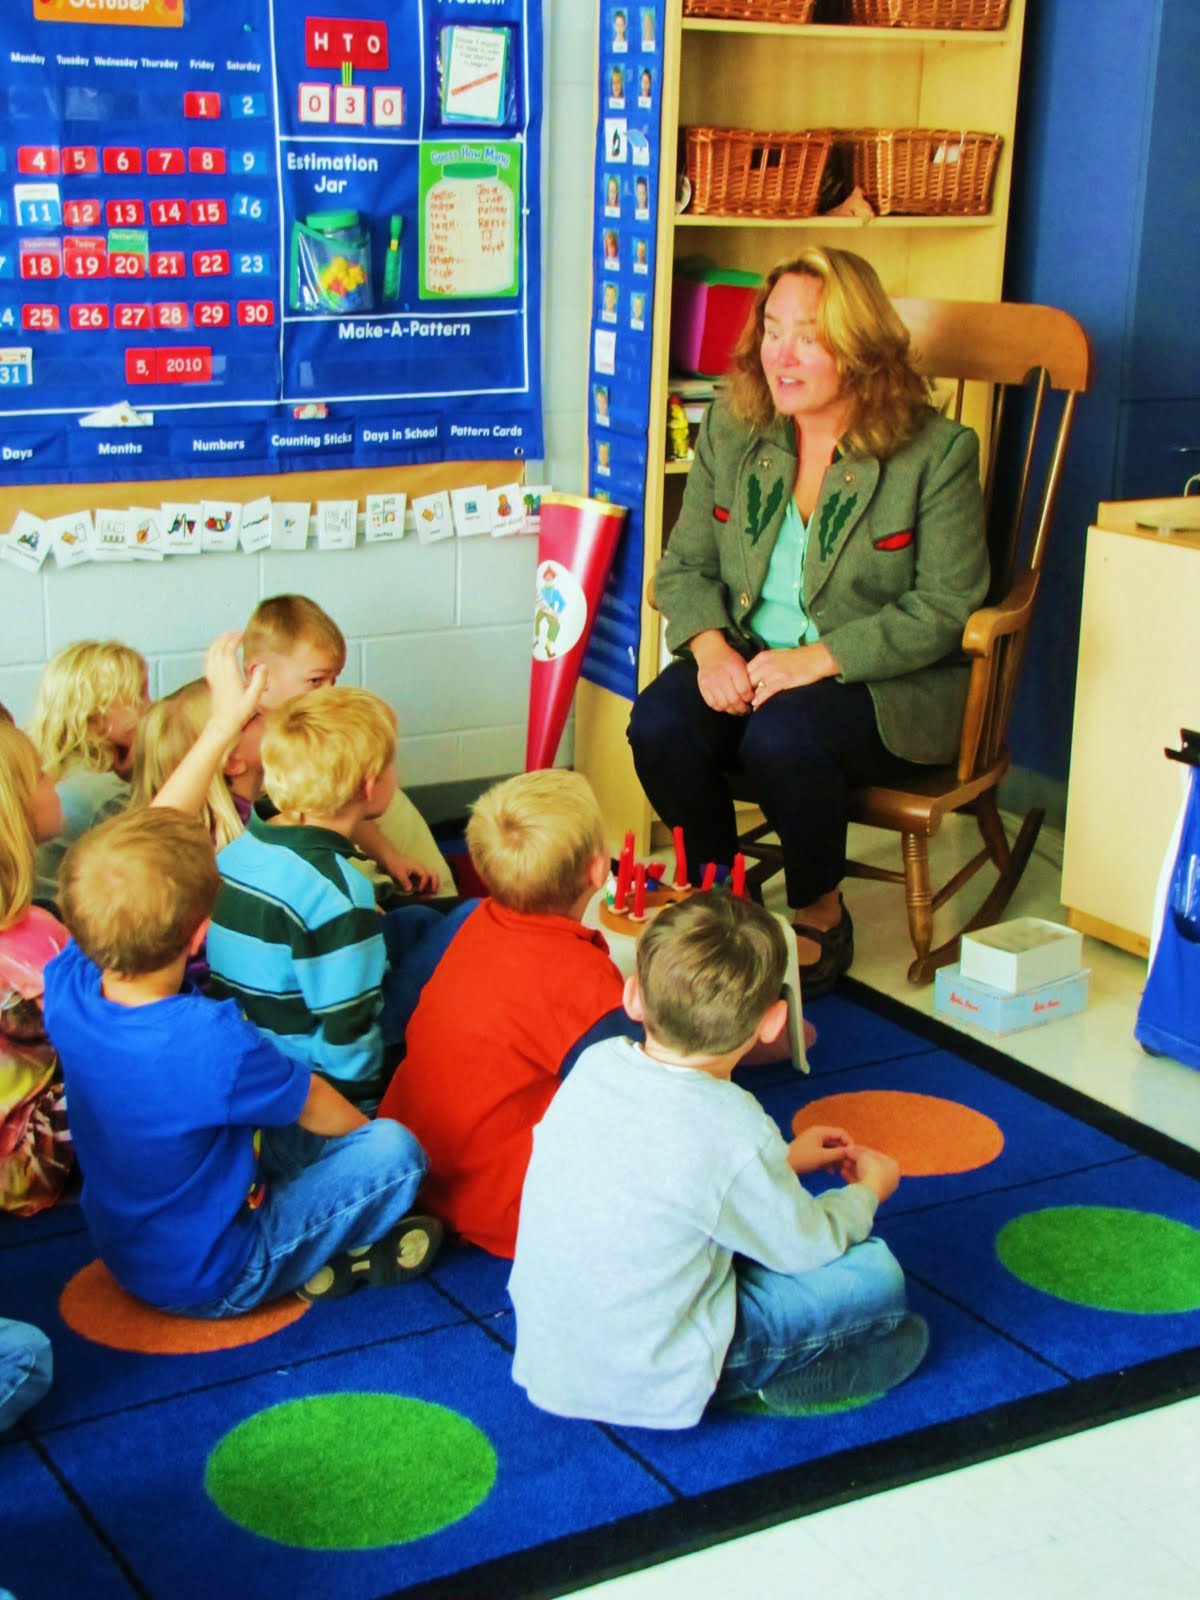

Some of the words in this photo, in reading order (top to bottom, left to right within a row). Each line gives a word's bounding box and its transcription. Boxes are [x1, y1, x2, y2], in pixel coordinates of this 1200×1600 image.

[314, 32, 329, 51] H
[343, 33, 354, 53] T
[10, 52, 46, 66] Monday
[56, 54, 90, 67] Tuesday
[94, 56, 139, 69] Wednesday
[141, 57, 179, 71] Thursday
[189, 58, 215, 72] Friday
[226, 60, 262, 73] Saturday
[198, 96, 208, 116] 1
[242, 96, 255, 115] 2
[308, 95, 322, 113] 0
[345, 97, 356, 115] 3
[382, 98, 395, 116] 0
[32, 151, 47, 171] 4
[73, 151, 87, 170] 5
[116, 152, 130, 171] 6
[159, 152, 173, 171] 7
[201, 152, 214, 171] 8
[242, 152, 255, 171] 9
[286, 152, 379, 172] Estimation
[461, 146, 482, 160] How
[484, 147, 509, 167] Many
[314, 176, 348, 193] Jar
[28, 203, 52, 223] 11
[72, 204, 94, 224] 12
[114, 205, 137, 223] 13
[158, 204, 181, 222] 14
[197, 204, 220, 222] 15
[239, 197, 262, 218] 16
[29, 257, 53, 275] 18
[75, 257, 99, 275] 19
[114, 256, 139, 274] 20
[157, 256, 178, 274] 21
[200, 254, 223, 273] 22
[240, 255, 264, 273] 23
[0, 308, 15, 328] 4
[29, 308, 54, 327] 25
[78, 308, 103, 326] 26
[121, 308, 146, 326] 27
[159, 307, 183, 326] 28
[201, 305, 224, 324] 29
[245, 304, 269, 323] 30
[338, 321, 471, 339] Make-A-Pattern
[166, 358, 203, 373] 2010
[0, 366, 21, 385] 31
[271, 434, 321, 448] Counting
[323, 432, 353, 446] Sticks
[363, 429, 390, 443] Days
[392, 429, 402, 441] in
[404, 426, 438, 440] School
[450, 425, 490, 438] Pattern
[492, 424, 523, 437] Cards
[2, 447, 34, 460] Days
[98, 442, 143, 455] Months
[192, 438, 245, 451] Numbers
